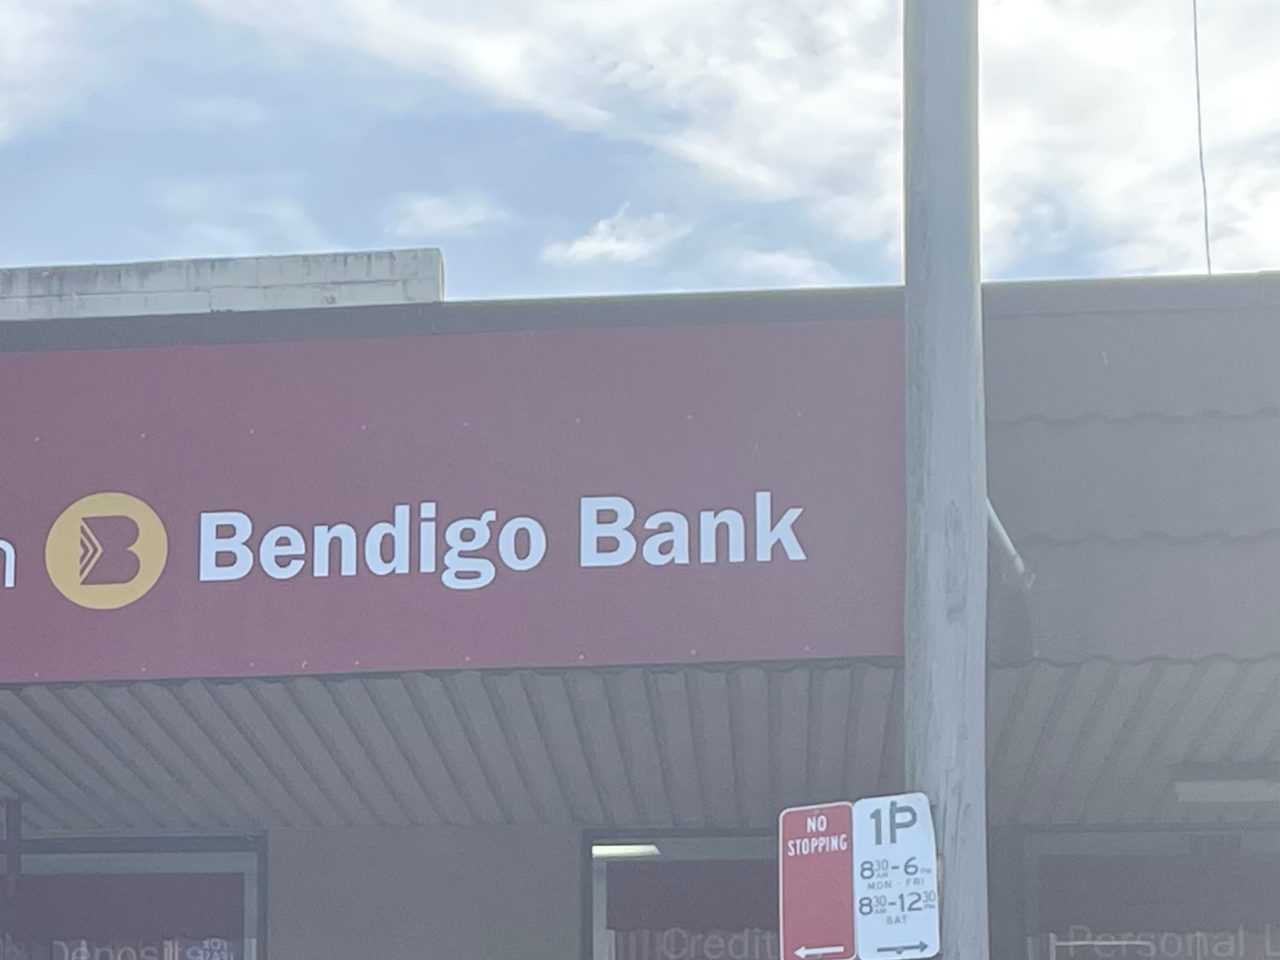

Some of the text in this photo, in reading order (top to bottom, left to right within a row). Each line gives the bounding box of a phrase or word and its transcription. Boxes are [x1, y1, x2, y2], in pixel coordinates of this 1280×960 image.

[199, 490, 808, 590] Bendigo Bank
[806, 815, 827, 833] NO
[870, 801, 918, 845] 1P
[787, 834, 848, 857] STOPPING
[867, 881, 893, 890] MON
[663, 927, 778, 960] Credit
[1069, 924, 1245, 958] Personal
